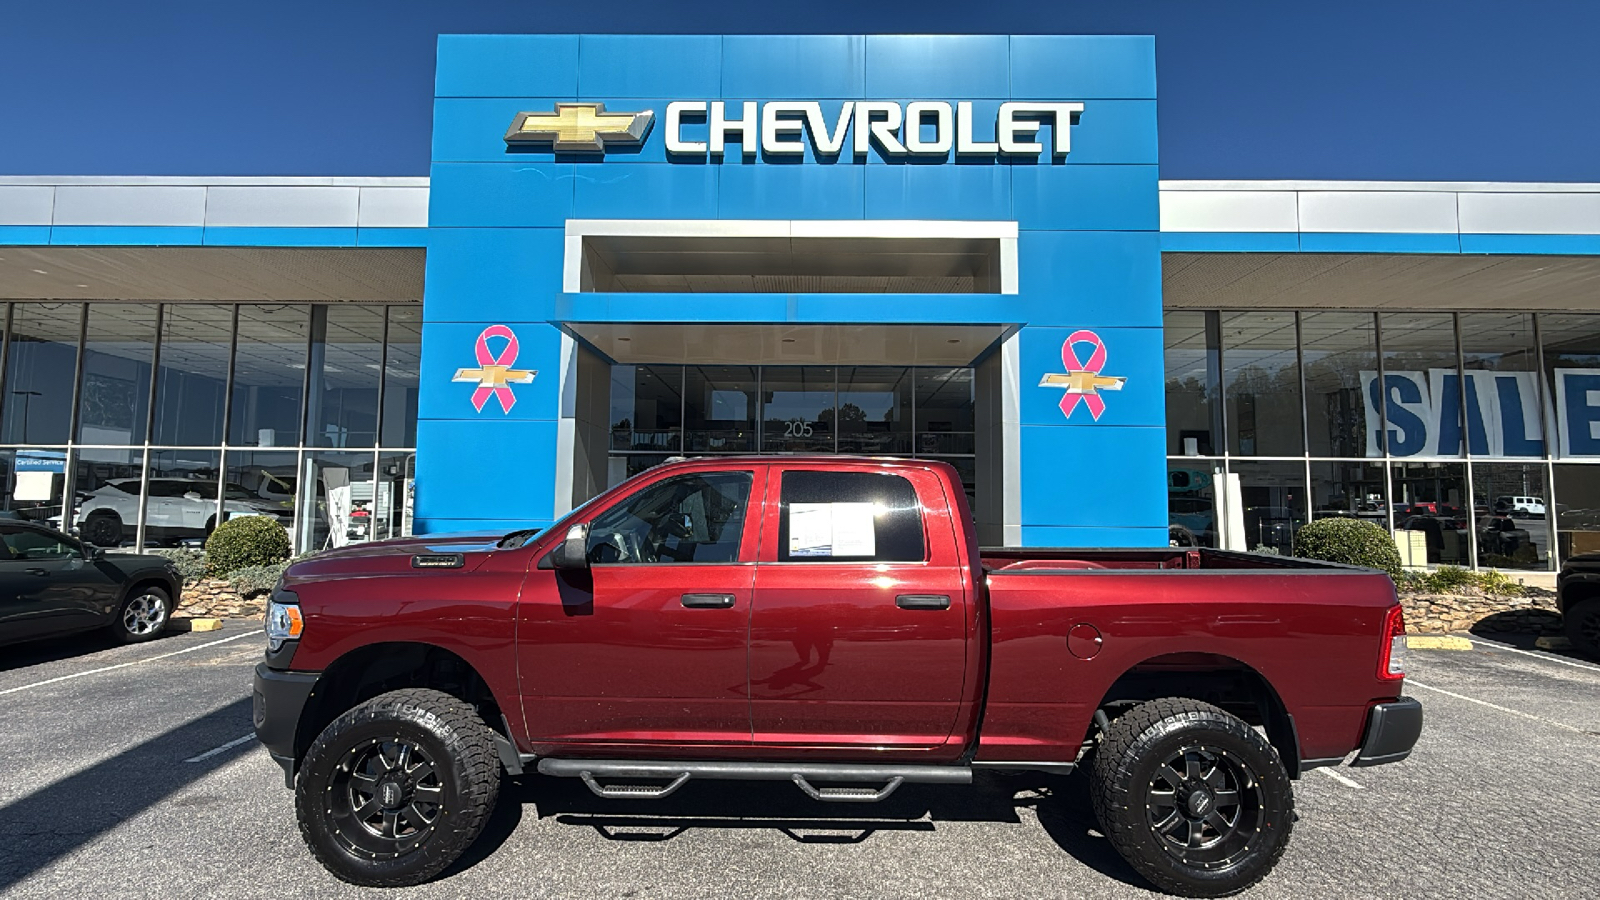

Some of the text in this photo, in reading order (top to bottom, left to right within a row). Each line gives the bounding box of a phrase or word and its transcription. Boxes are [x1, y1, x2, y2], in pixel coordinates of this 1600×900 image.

[665, 101, 1084, 156] CHEVROLET
[784, 421, 813, 437] 205
[1369, 374, 1600, 457] SALE
